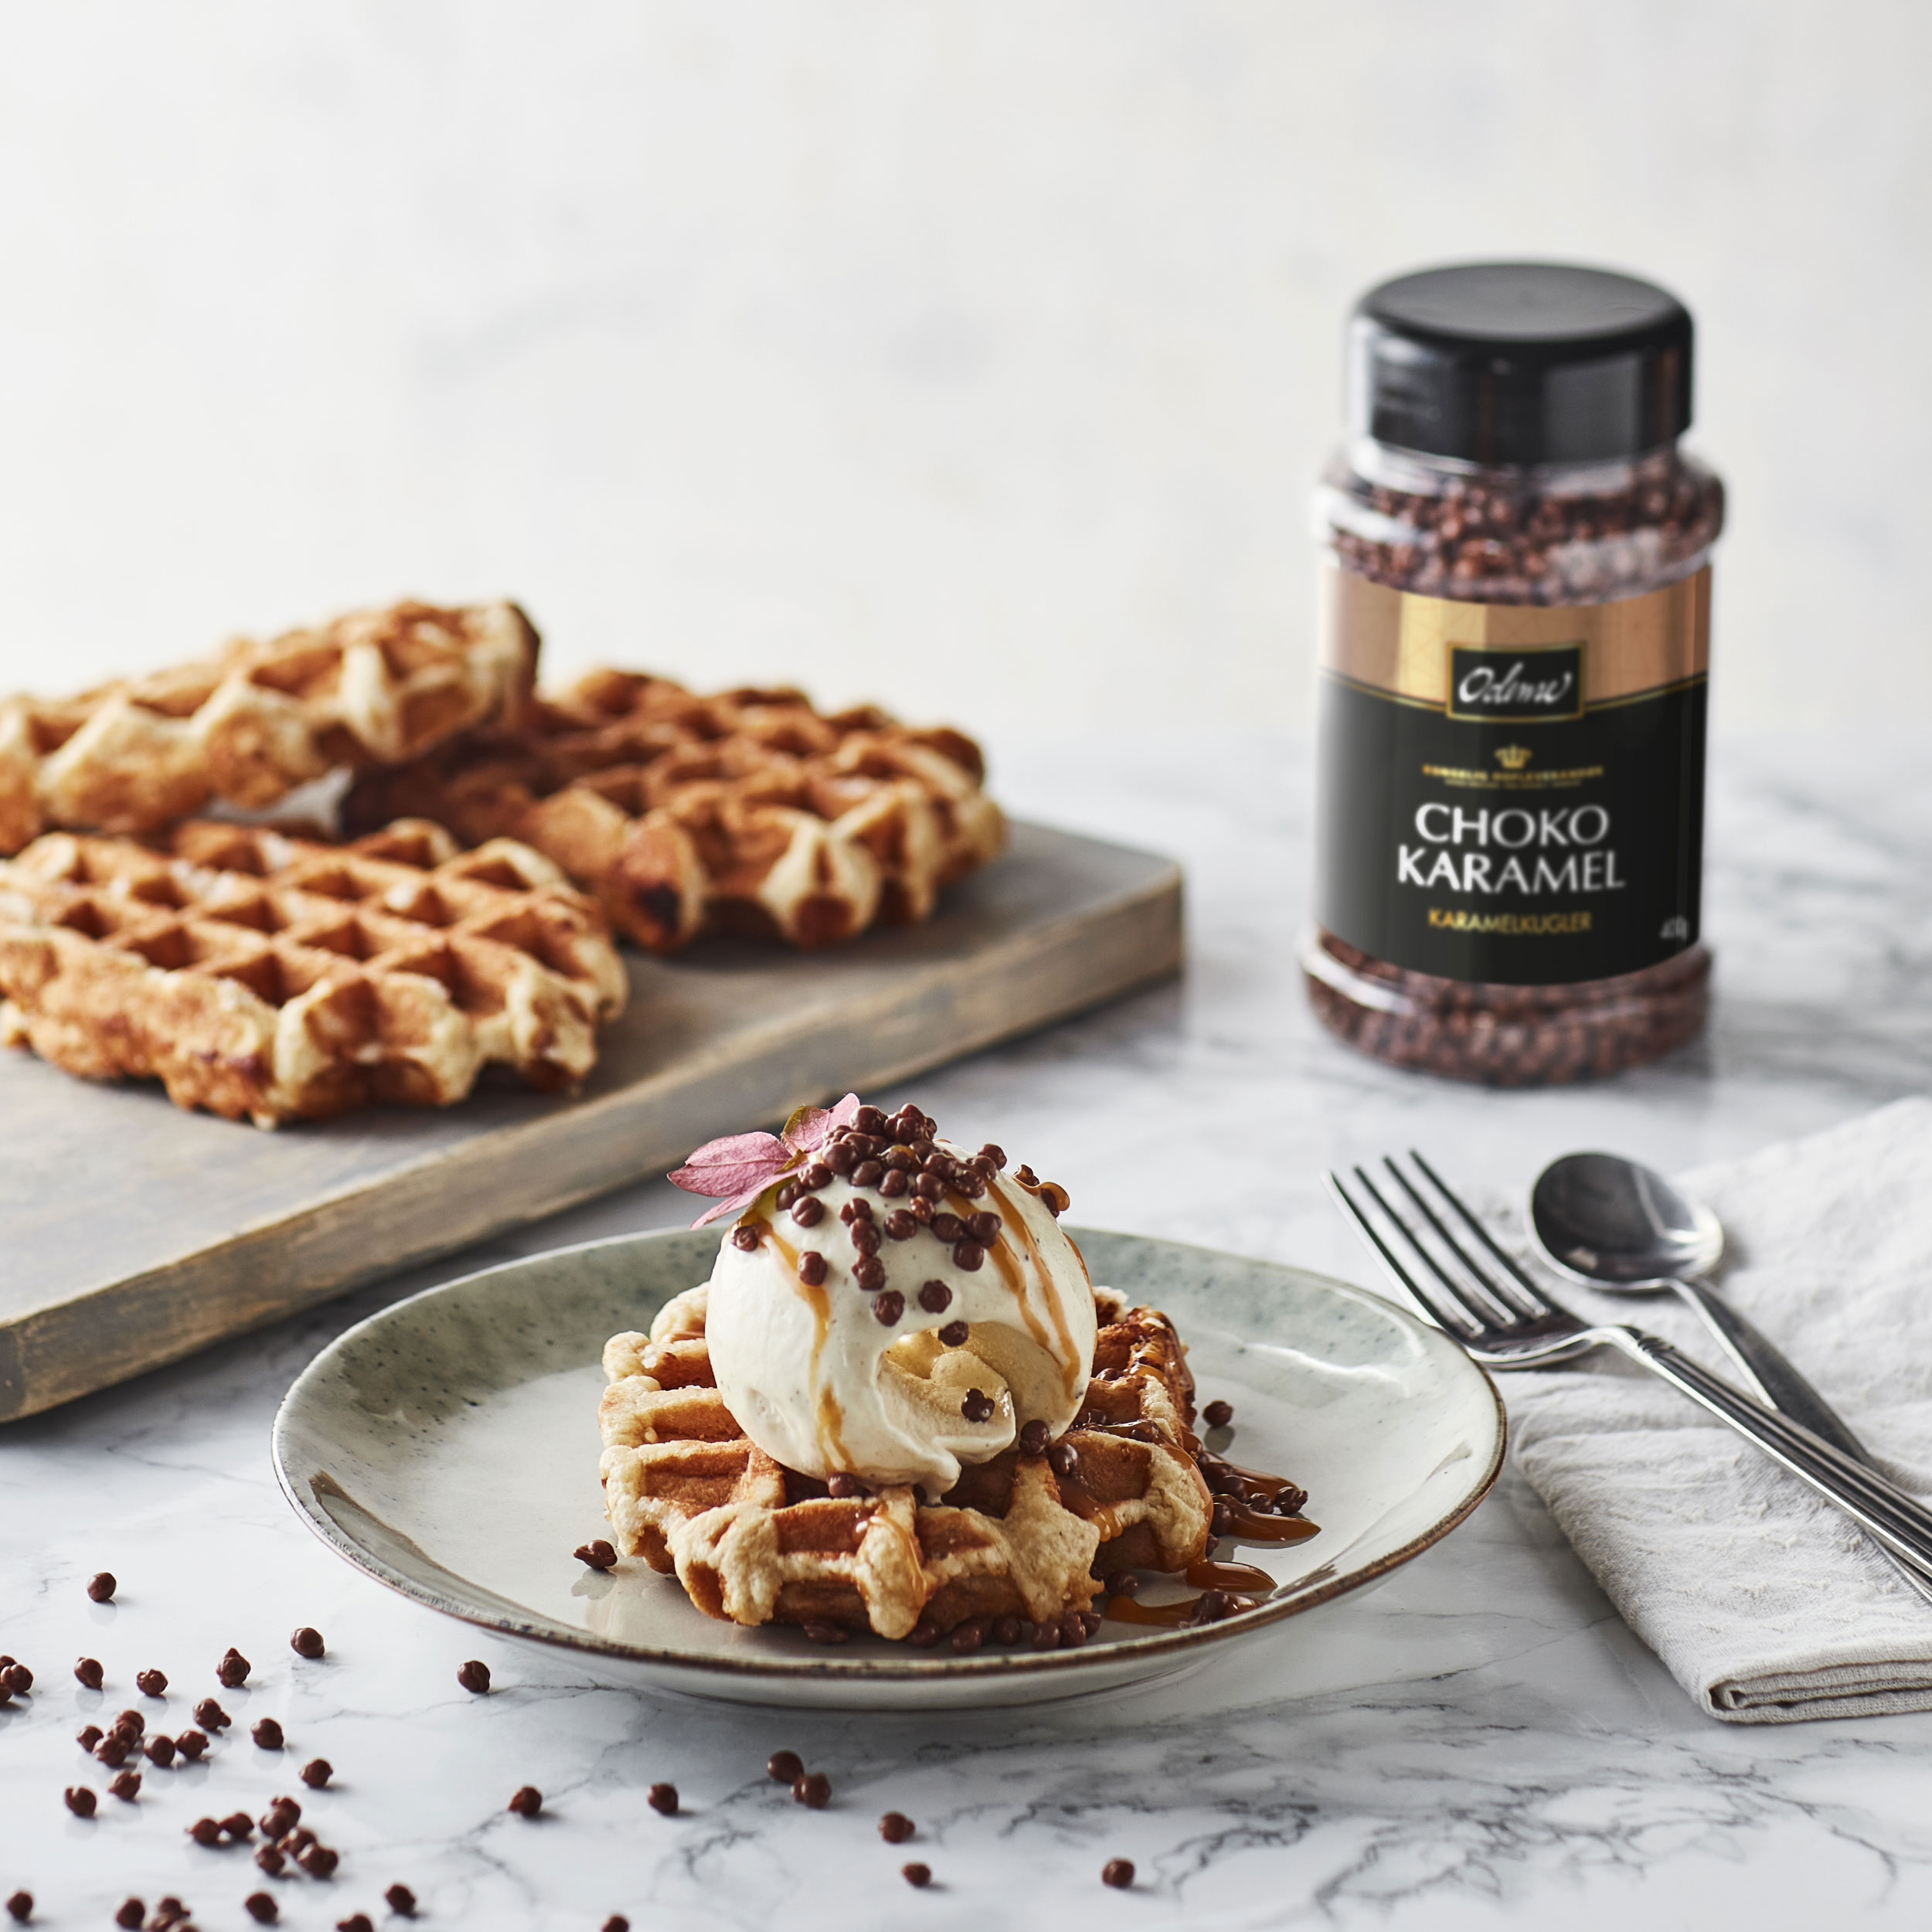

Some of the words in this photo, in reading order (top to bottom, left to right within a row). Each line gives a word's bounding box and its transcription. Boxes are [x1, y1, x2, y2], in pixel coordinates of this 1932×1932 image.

[1415, 802, 1609, 848] CHOKO
[1398, 844, 1626, 894] KARAMEL
[1428, 906, 1592, 934] KARAMELKUGLER
